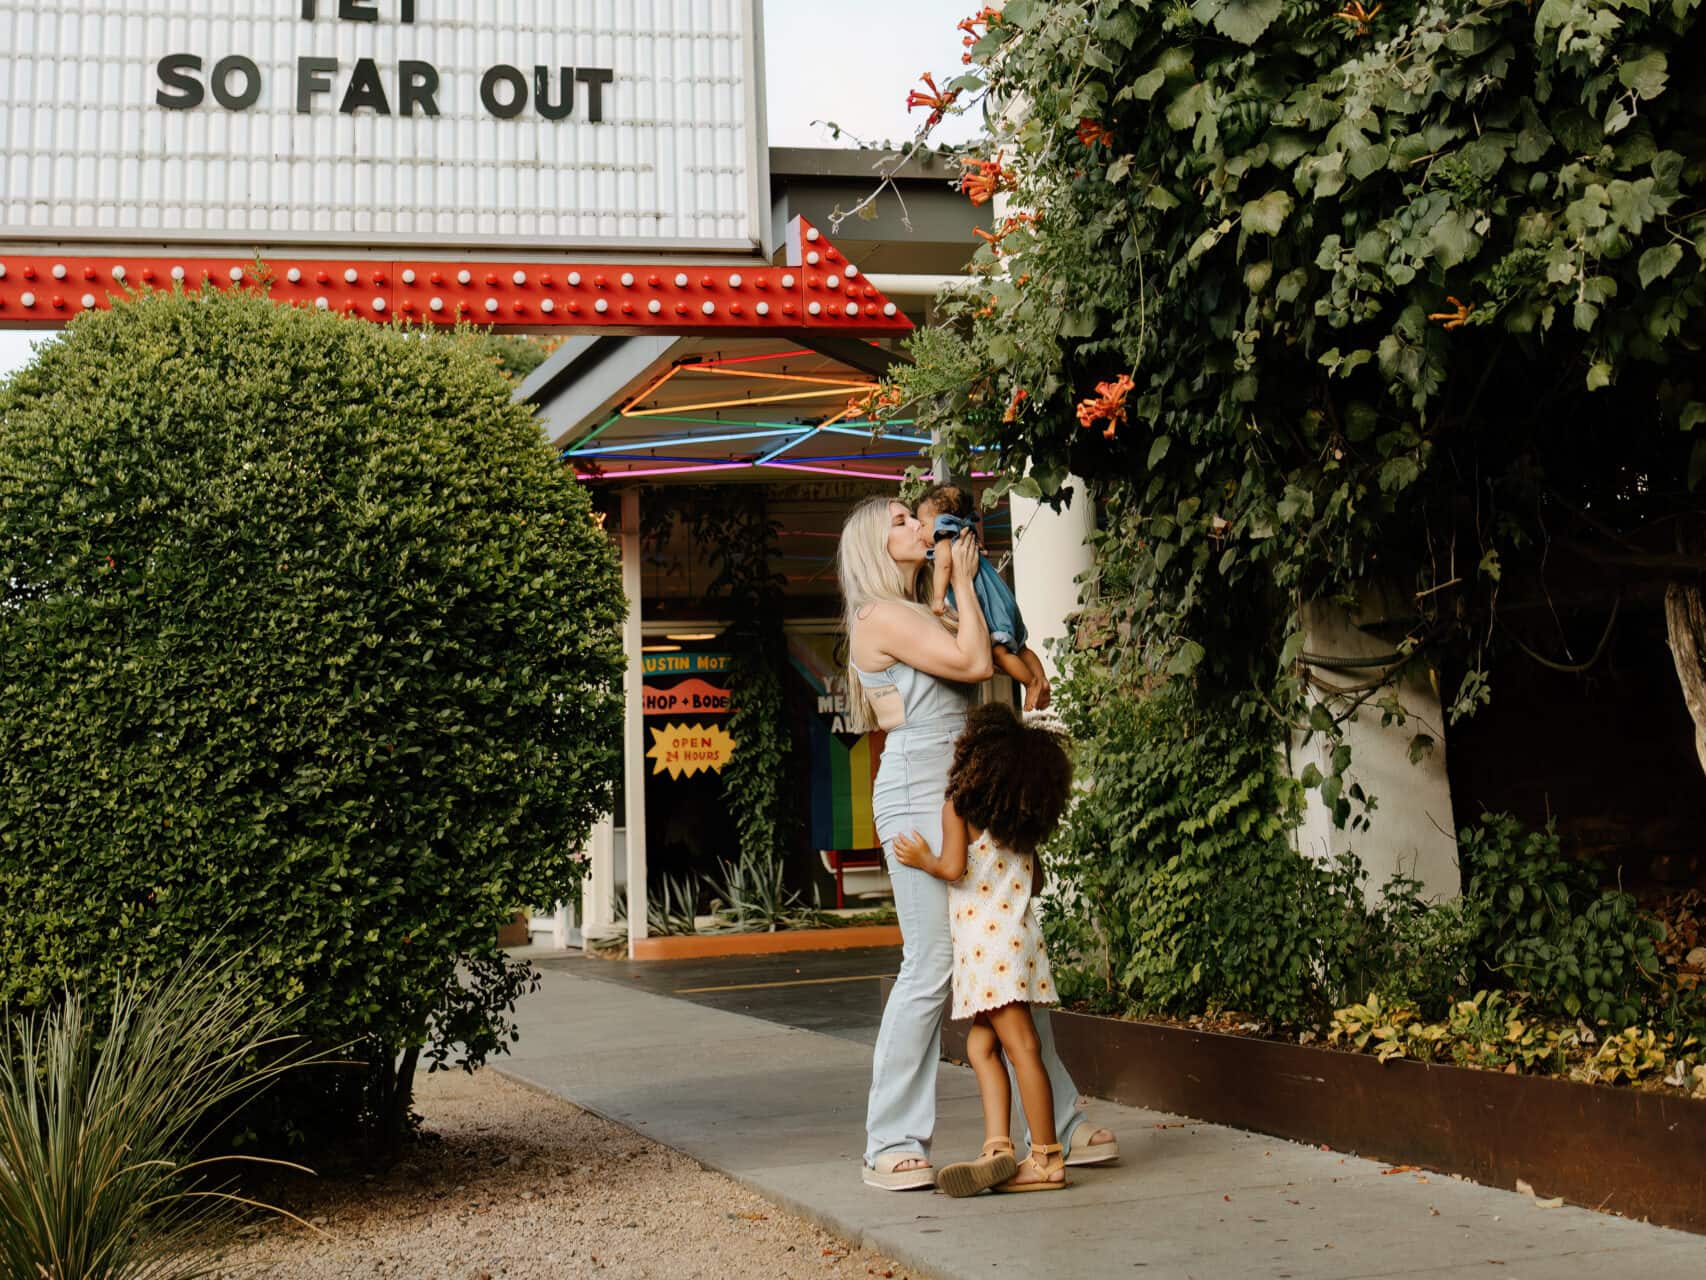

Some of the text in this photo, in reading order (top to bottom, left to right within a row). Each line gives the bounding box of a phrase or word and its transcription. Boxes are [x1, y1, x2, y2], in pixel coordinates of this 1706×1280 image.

[156, 53, 614, 124] SO FAR OUT
[642, 694, 677, 710] HOP
[692, 693, 730, 709] BODE
[672, 736, 712, 749] OPEN
[665, 750, 720, 763] 24 HOURS
